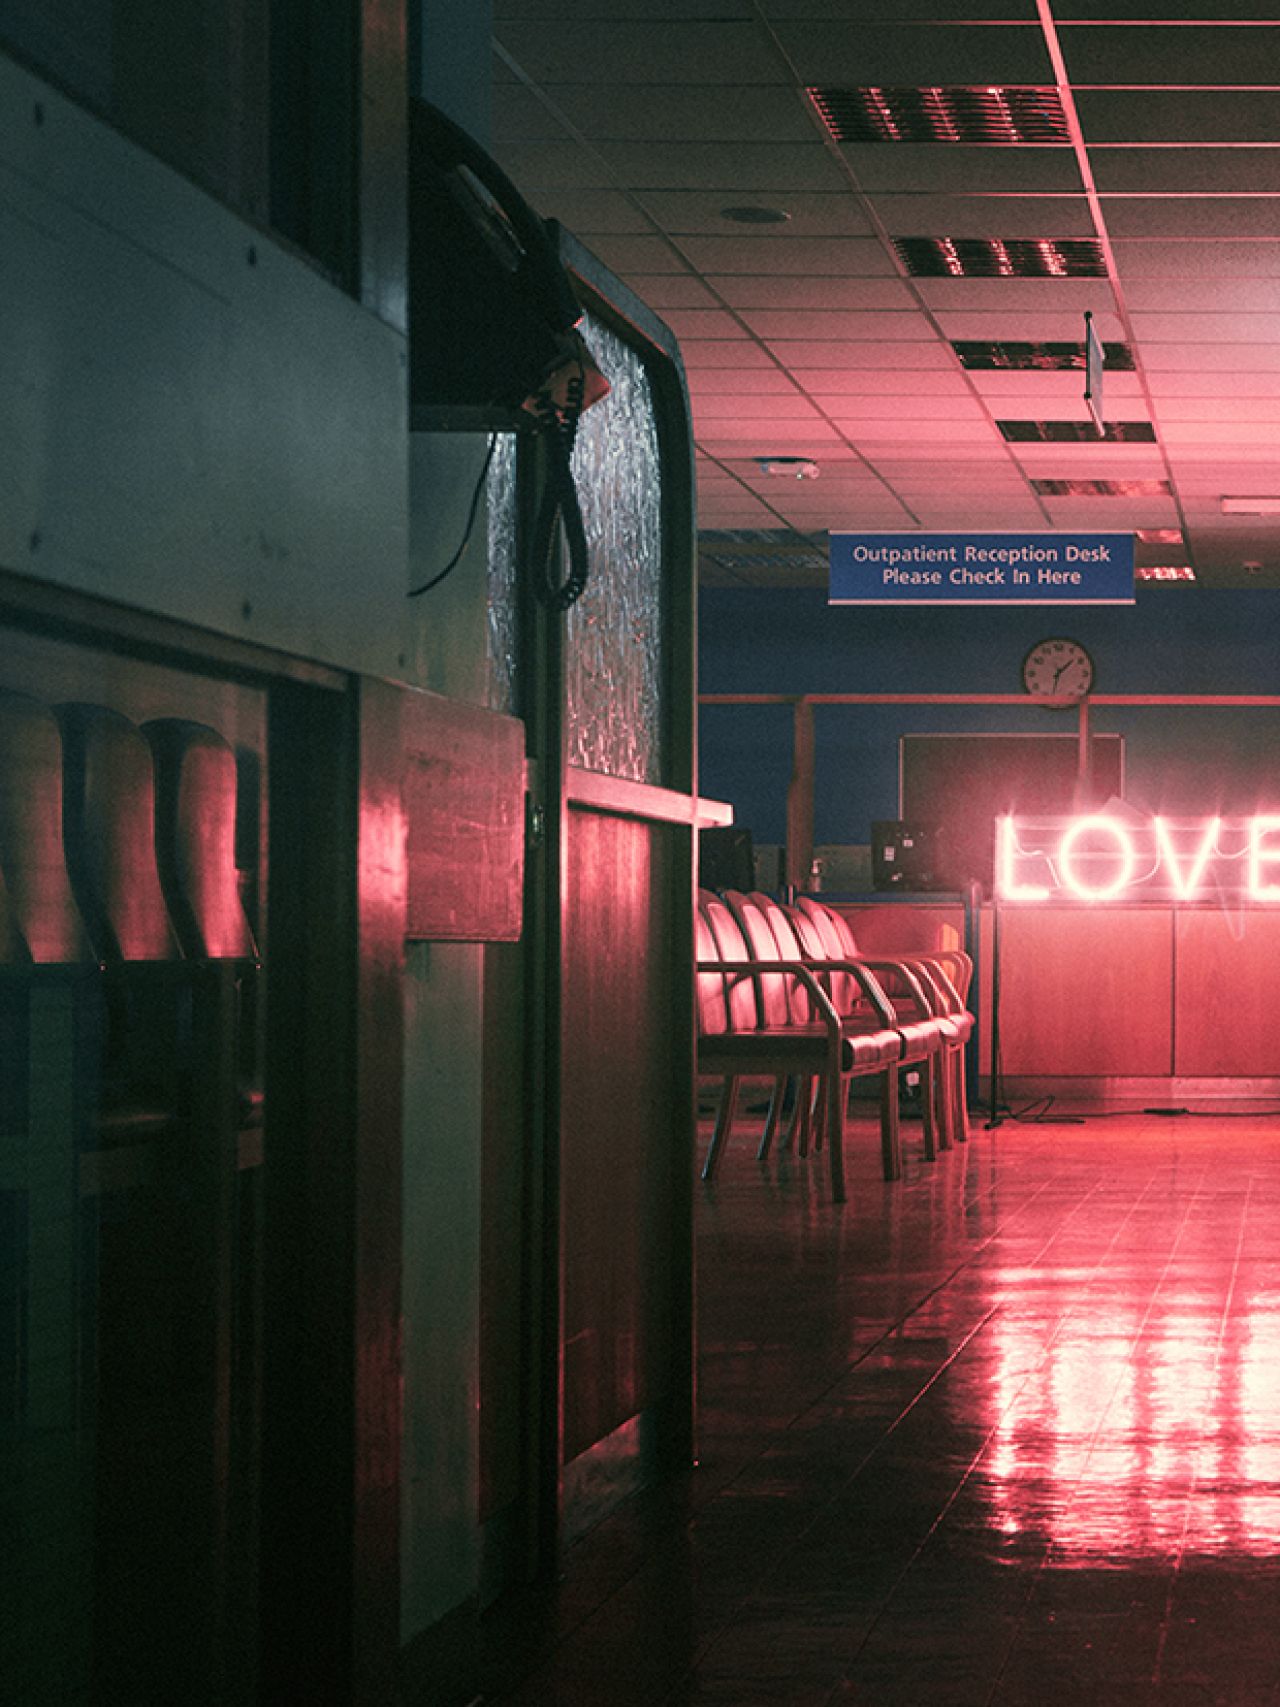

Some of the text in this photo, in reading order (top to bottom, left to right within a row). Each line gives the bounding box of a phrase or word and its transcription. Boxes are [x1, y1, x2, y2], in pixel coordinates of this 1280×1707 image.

[853, 545, 1110, 565] Outpatient Reception Desk
[883, 568, 1082, 585] Please Check In Here
